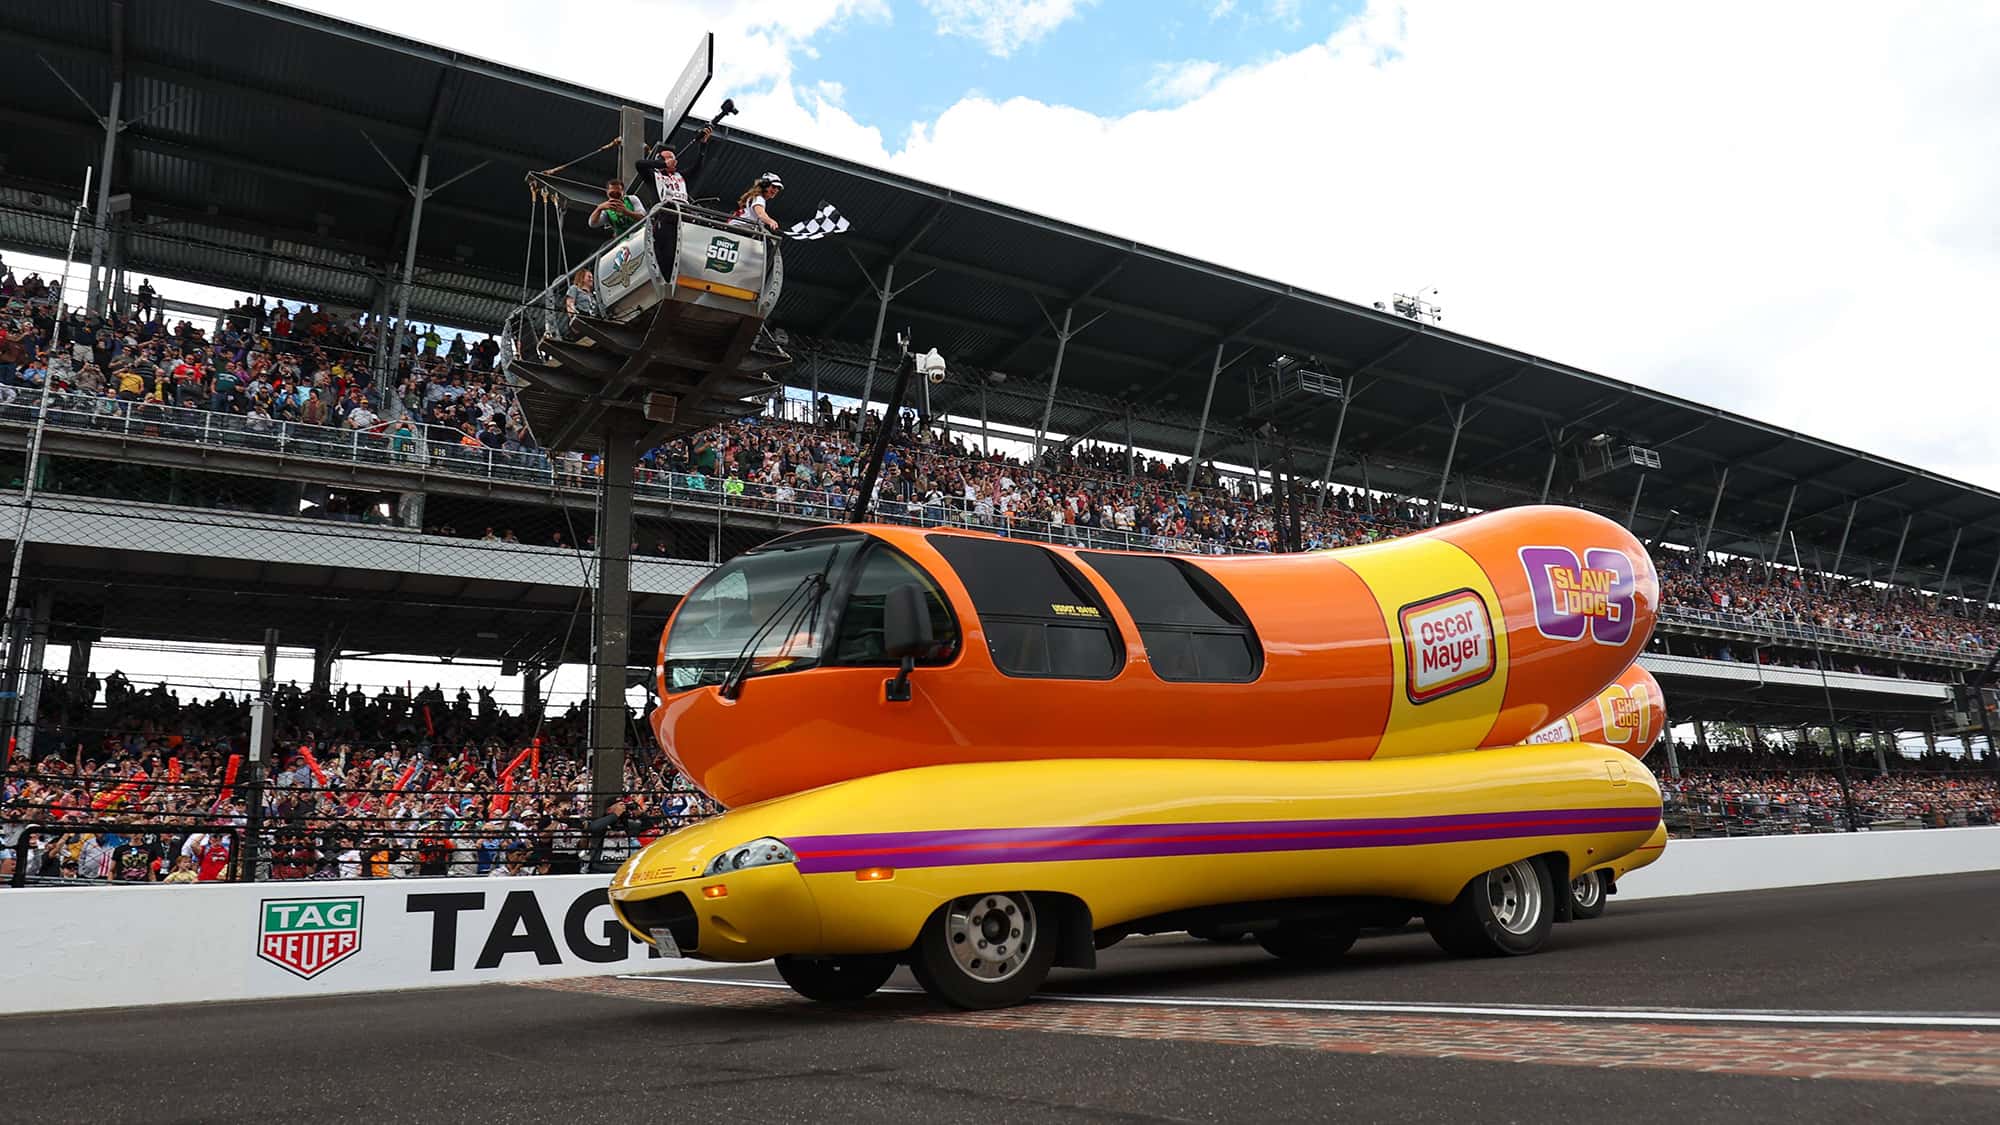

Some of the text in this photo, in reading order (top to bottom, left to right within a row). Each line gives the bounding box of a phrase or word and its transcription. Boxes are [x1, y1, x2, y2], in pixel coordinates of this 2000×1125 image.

[707, 245, 738, 263] 500
[716, 240, 735, 249] INDY
[1552, 568, 1611, 593] SLAW
[1569, 591, 1607, 616] DOG
[1421, 610, 1474, 646] Oscar
[1422, 633, 1481, 673] Mayer
[1618, 712, 1640, 727] DOG
[271, 904, 352, 928] TAG
[406, 887, 630, 971] TAG
[266, 933, 353, 970] HEUER
